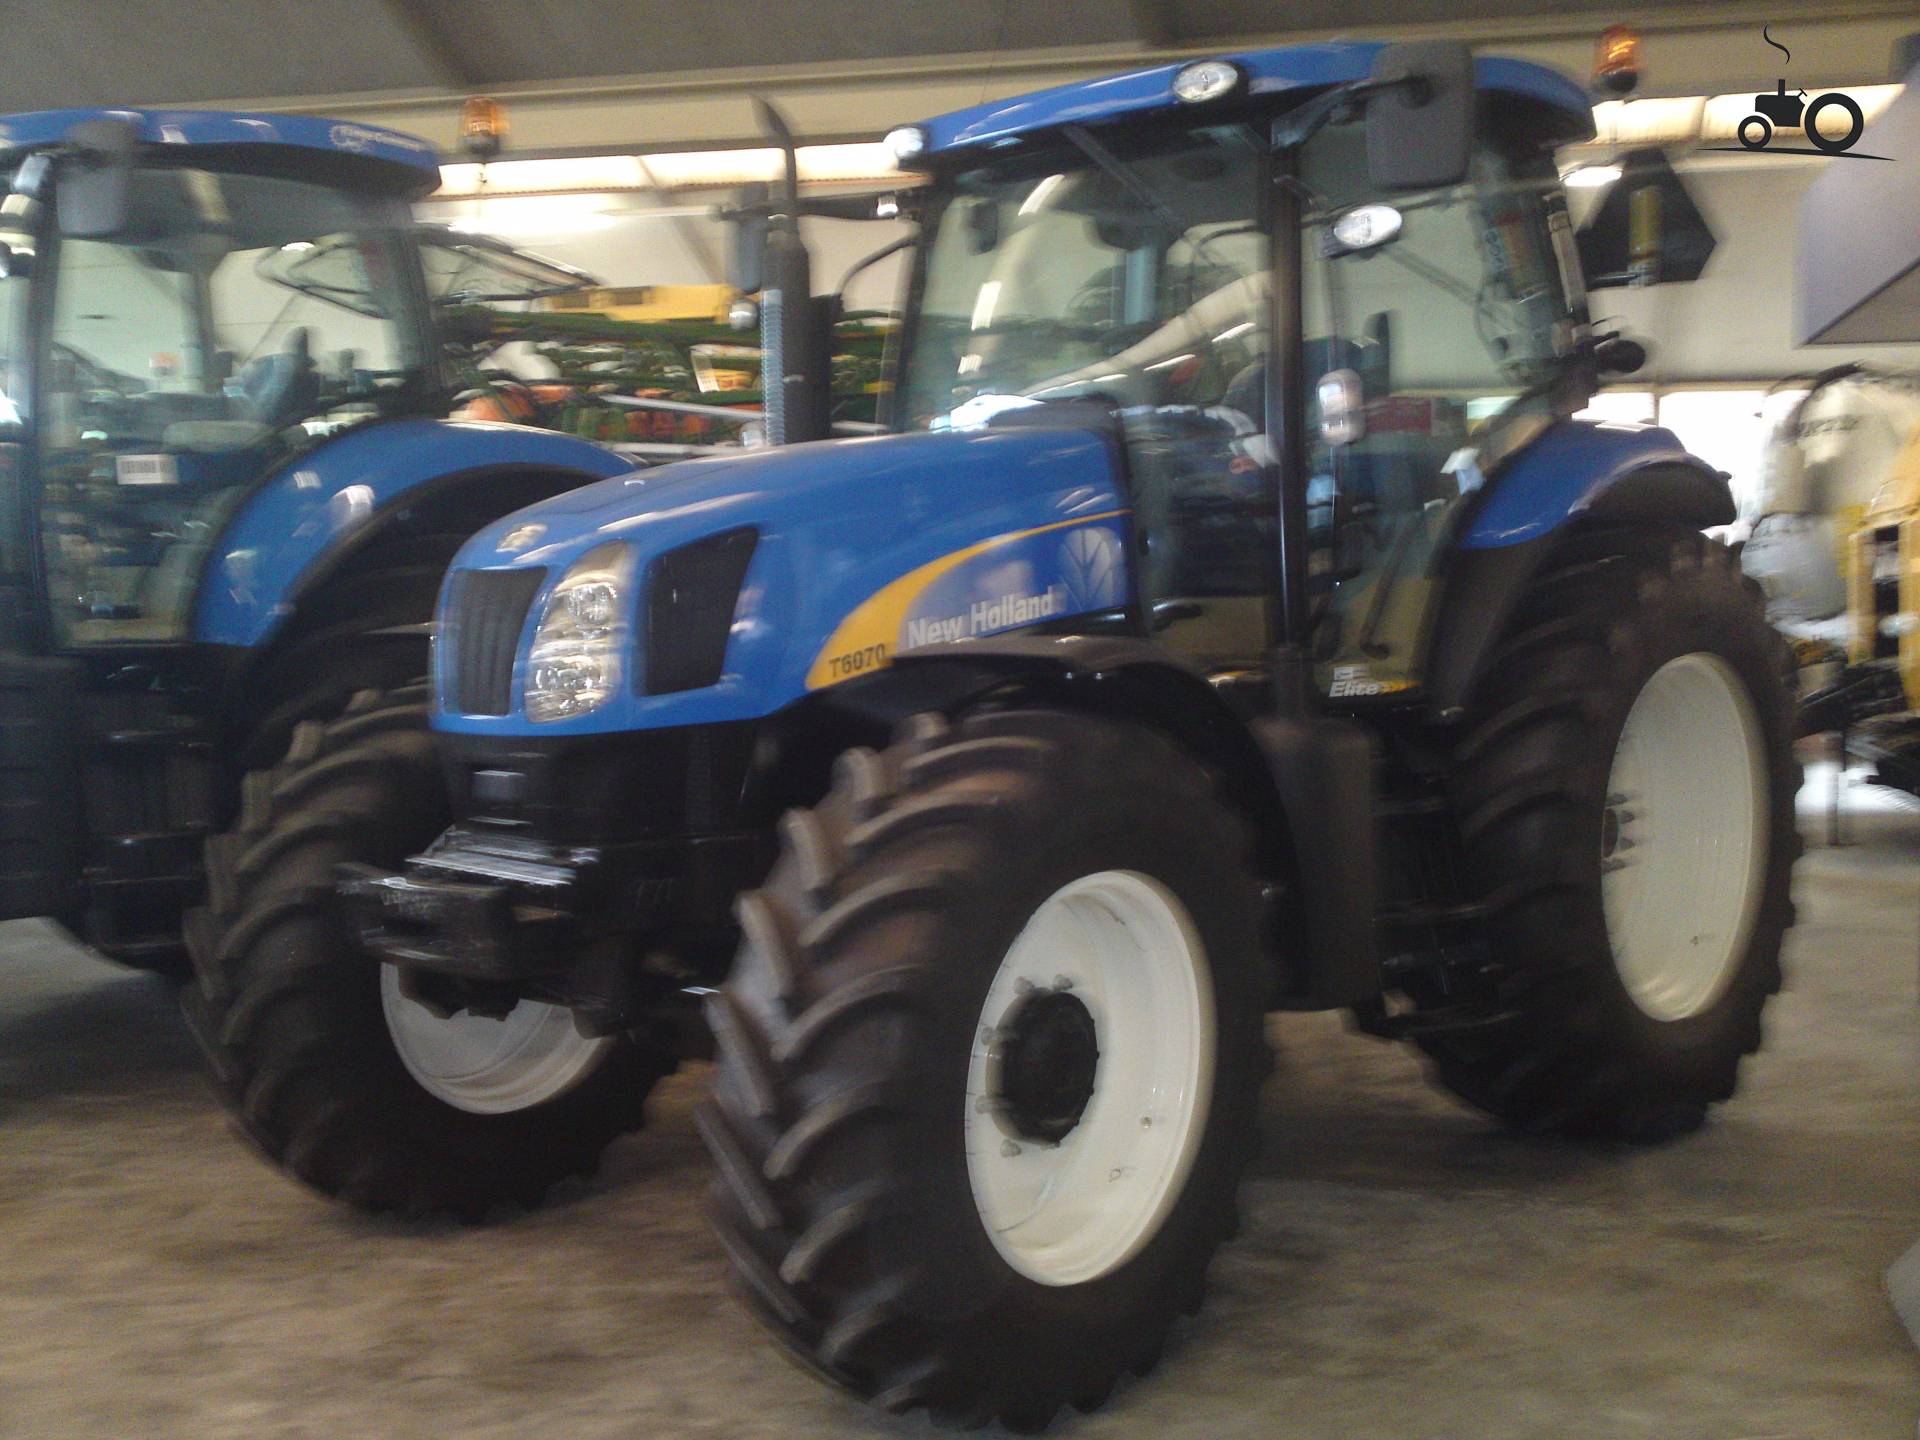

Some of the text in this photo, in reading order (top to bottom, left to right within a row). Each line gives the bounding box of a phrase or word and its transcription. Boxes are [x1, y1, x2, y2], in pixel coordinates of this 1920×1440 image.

[907, 586, 1055, 648] New Holland
[828, 643, 886, 678] T6070
[1329, 680, 1380, 697] Elite
